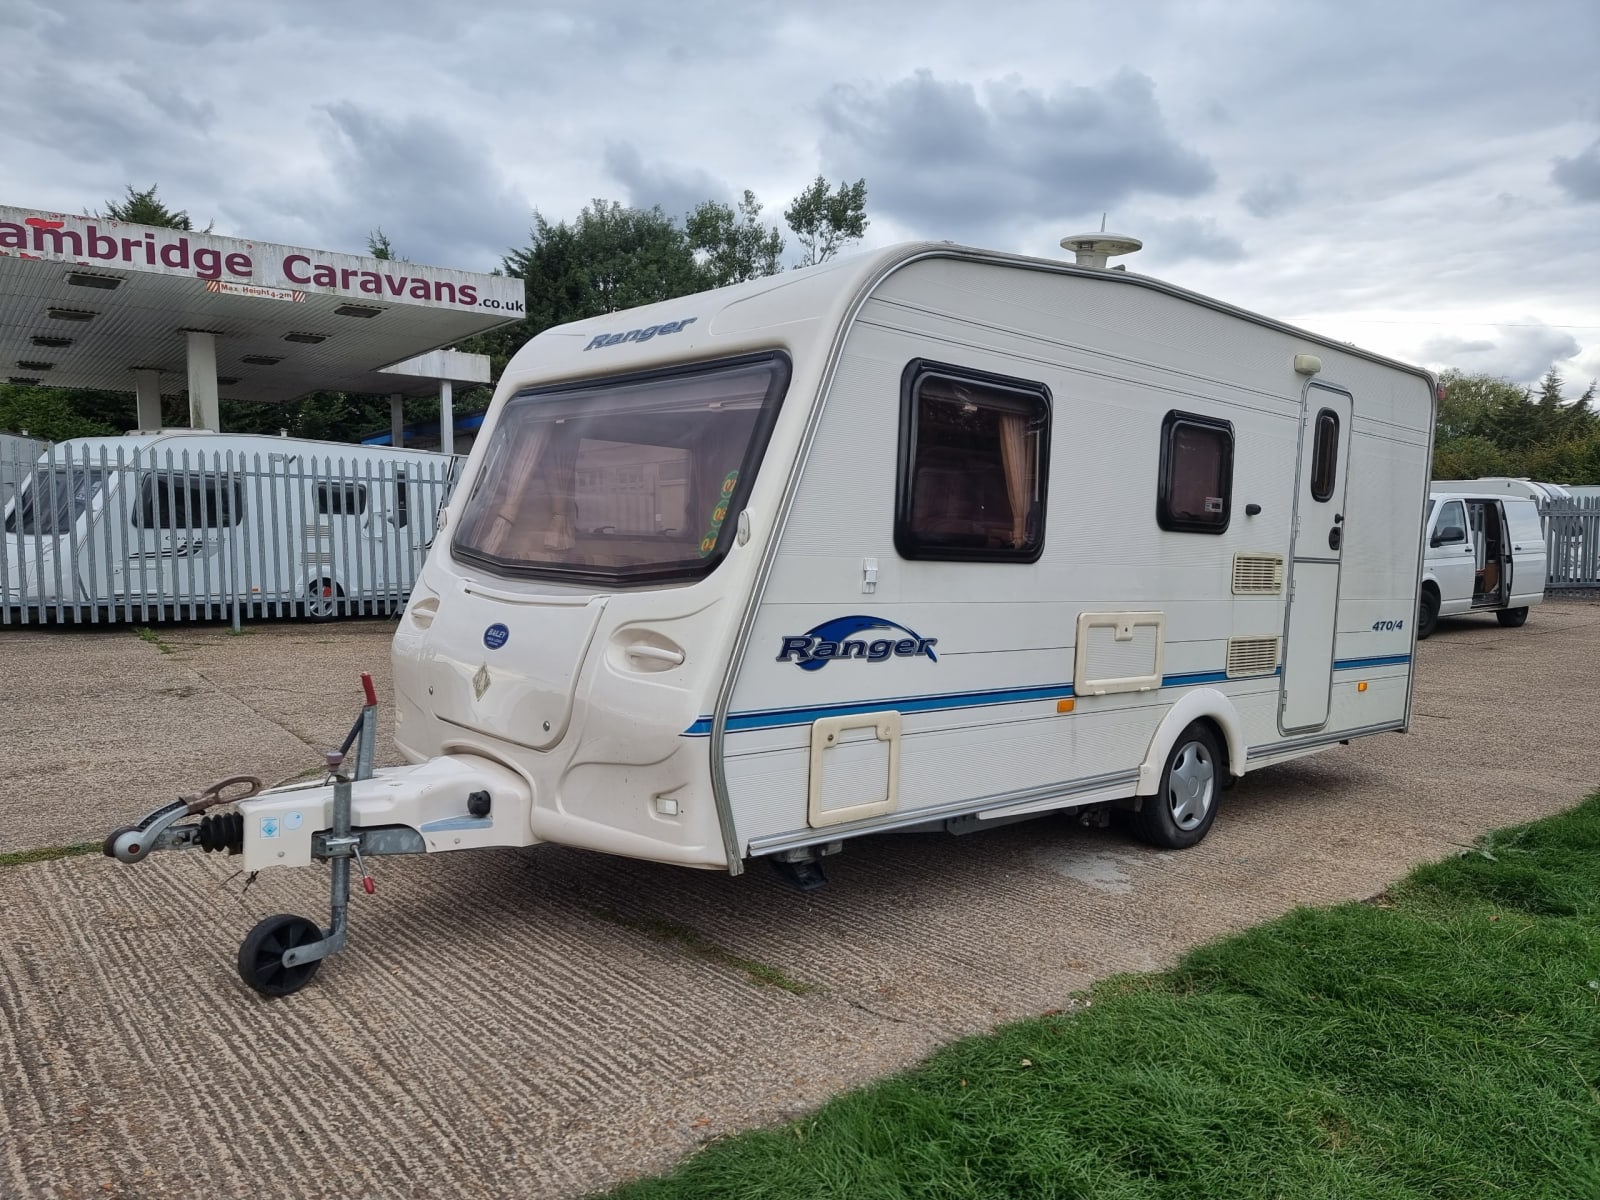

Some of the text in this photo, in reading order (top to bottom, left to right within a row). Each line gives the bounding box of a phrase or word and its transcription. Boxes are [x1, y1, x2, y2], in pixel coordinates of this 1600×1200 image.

[221, 284, 239, 292] Max
[242, 286, 270, 296] Height
[283, 254, 478, 306] Caravans
[583, 317, 698, 352] Ranger
[1372, 620, 1403, 632] 470/4
[776, 636, 938, 663] Ranger
